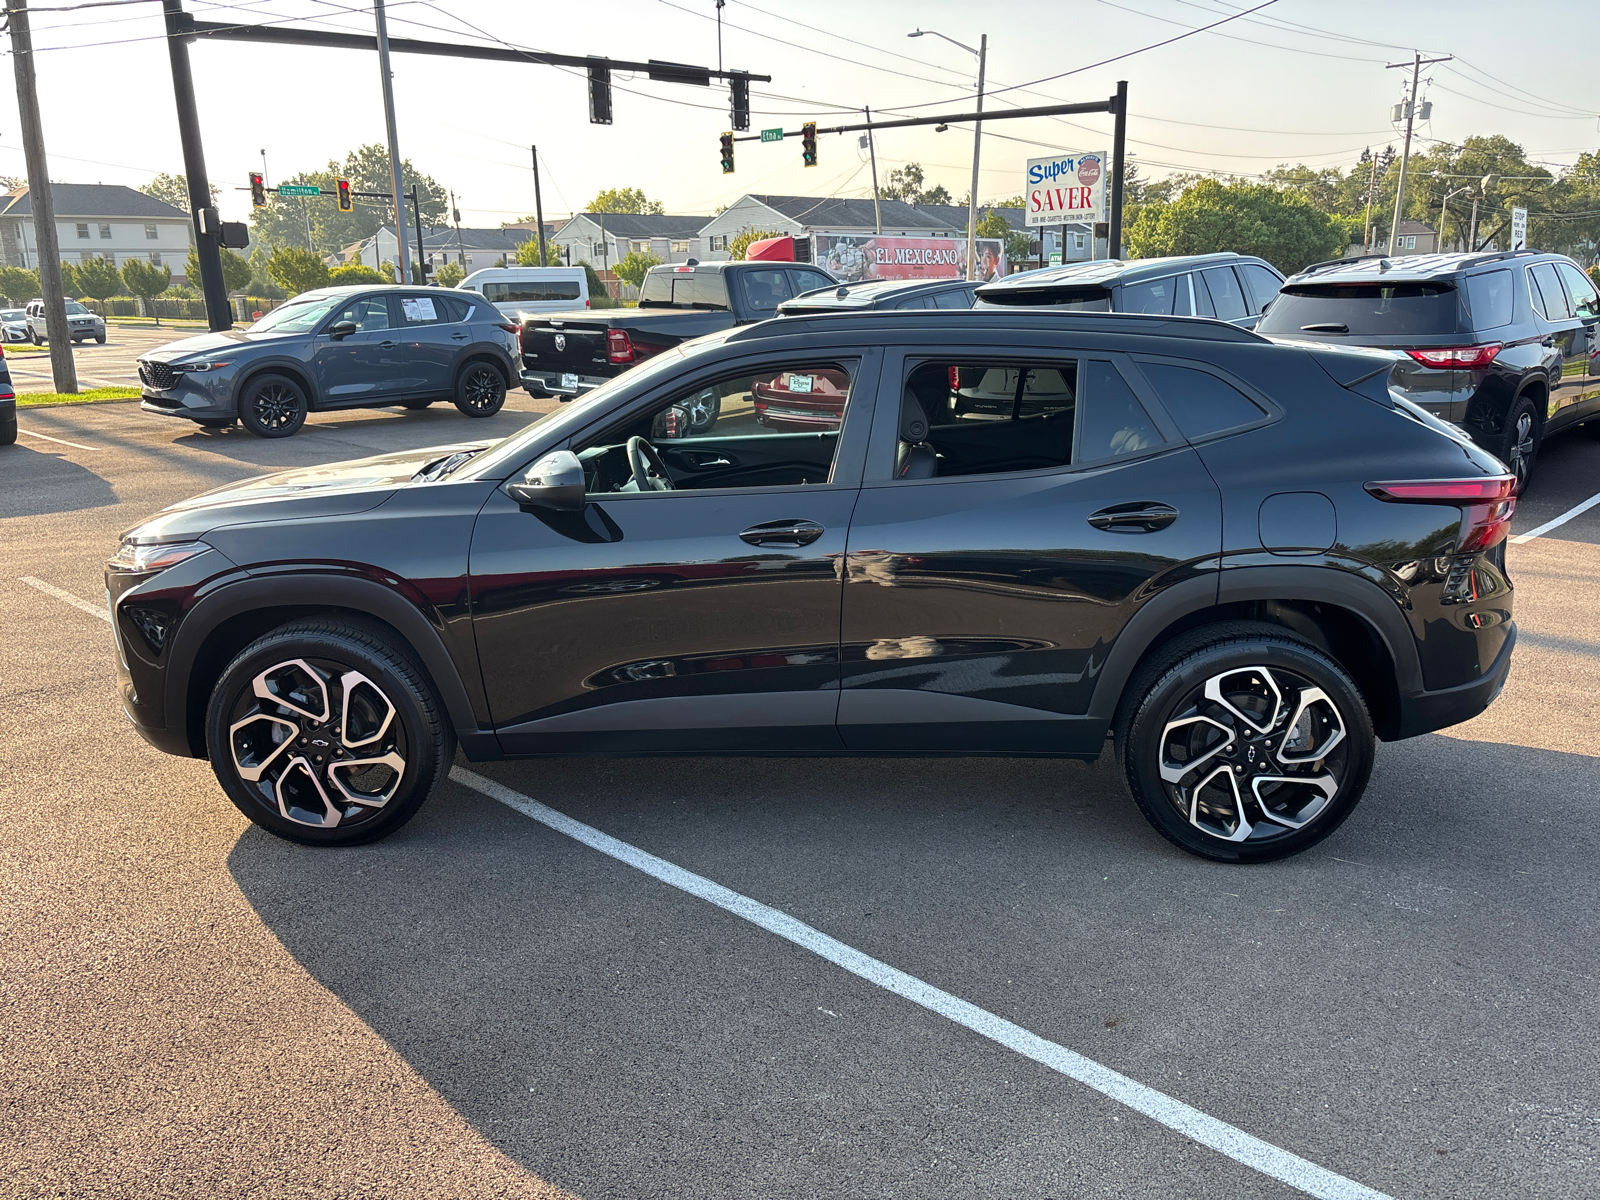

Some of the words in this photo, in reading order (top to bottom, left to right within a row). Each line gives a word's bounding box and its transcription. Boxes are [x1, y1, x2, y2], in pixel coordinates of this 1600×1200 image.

[762, 131, 776, 141] Etna
[1079, 155, 1099, 164] ALWAYS
[1029, 158, 1074, 184] Super
[281, 187, 313, 195] Hamilton
[1030, 186, 1092, 213] SAVER
[1514, 212, 1525, 220] STOP
[1515, 230, 1523, 238] RED
[875, 248, 893, 264] EL
[894, 248, 958, 265] MEXICANO
